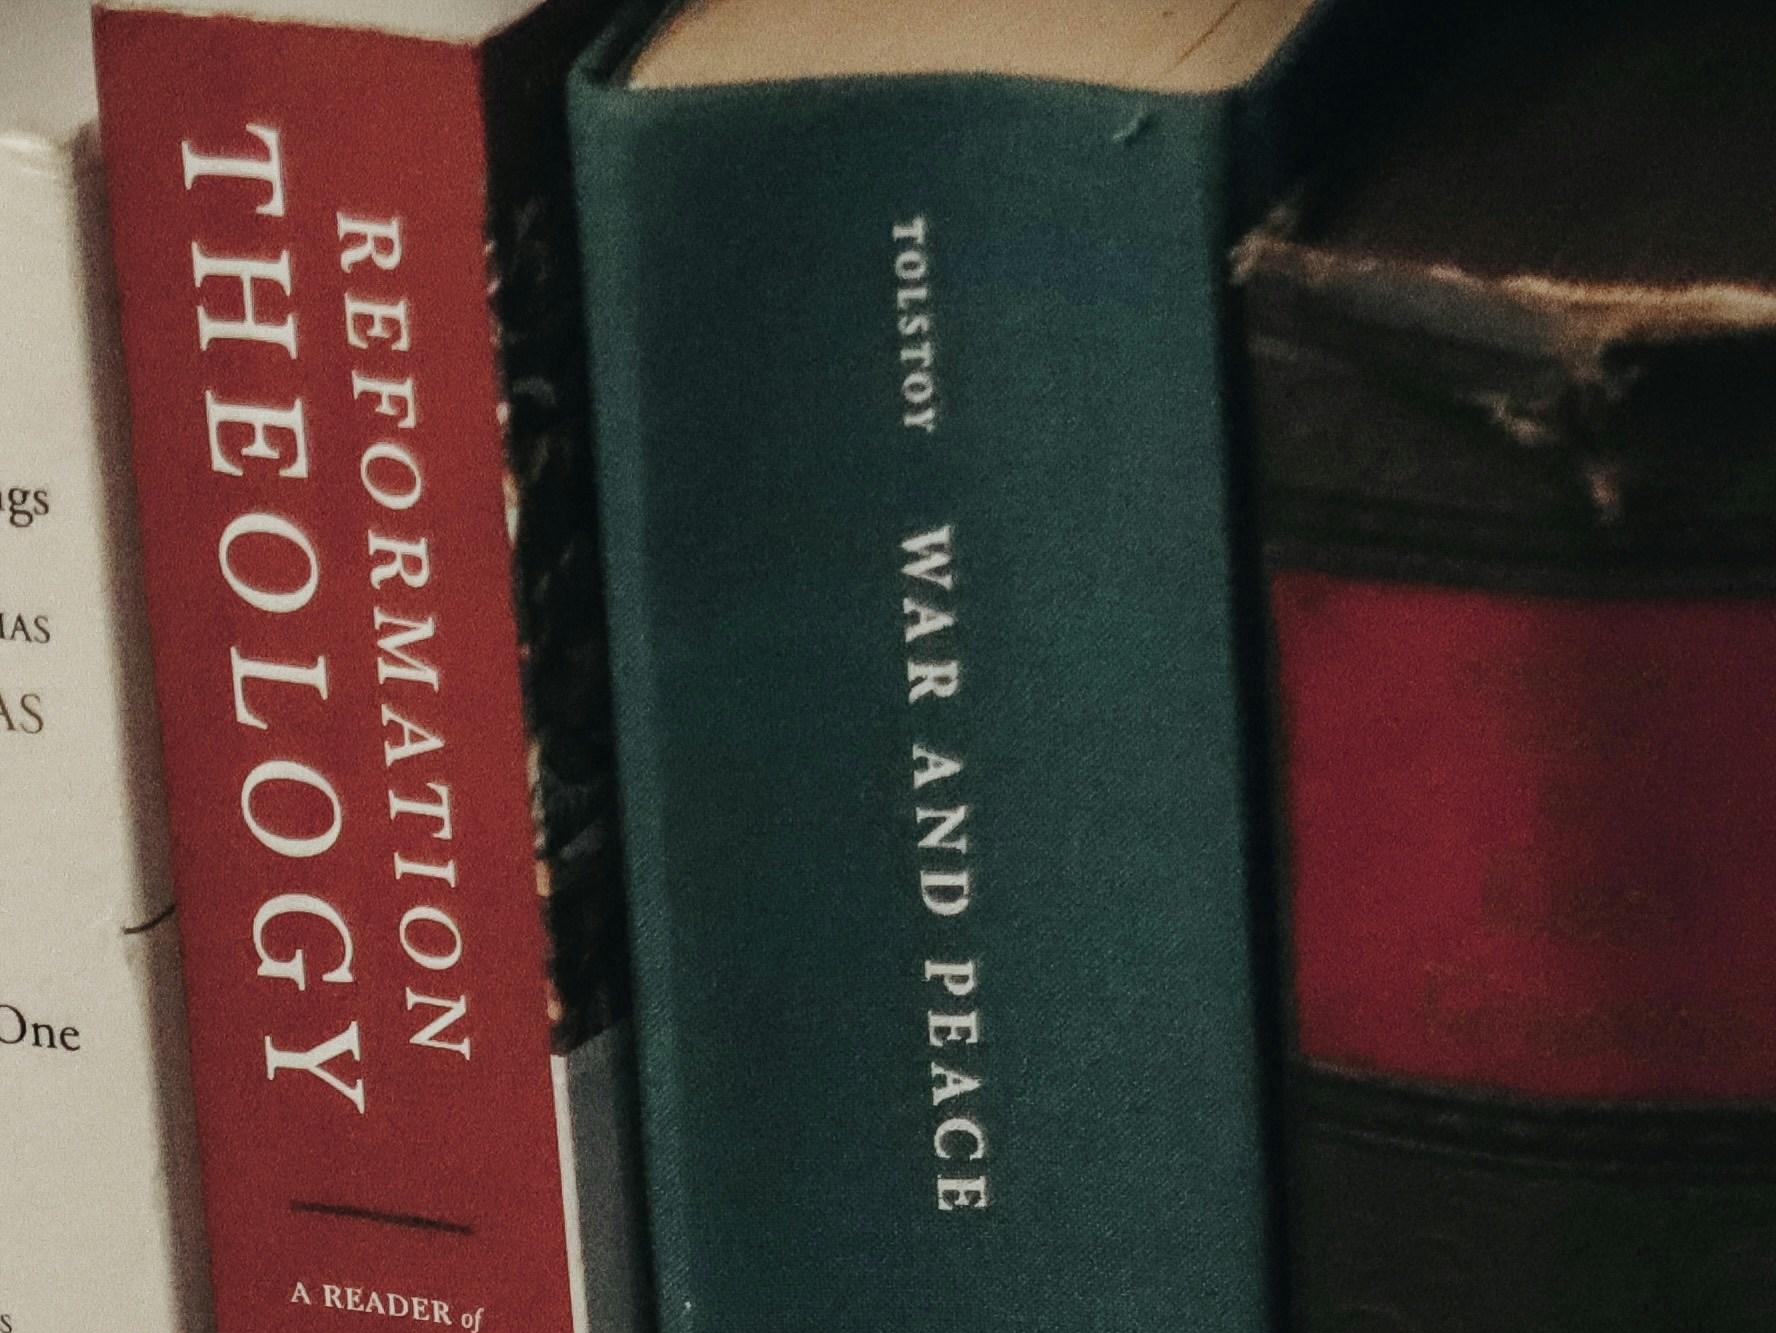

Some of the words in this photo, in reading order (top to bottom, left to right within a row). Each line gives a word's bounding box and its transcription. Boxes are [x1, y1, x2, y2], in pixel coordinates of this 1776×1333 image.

[892, 214, 937, 433] TOLSTOY
[181, 122, 366, 1114] THEOLOGY
[336, 211, 470, 1061] REFORMATION
[899, 525, 959, 704] WAR
[912, 741, 974, 917] AND
[924, 957, 987, 1210] PEACE
[291, 1281, 311, 1305] A
[323, 1285, 453, 1325] READER
[460, 1307, 485, 1333] of
